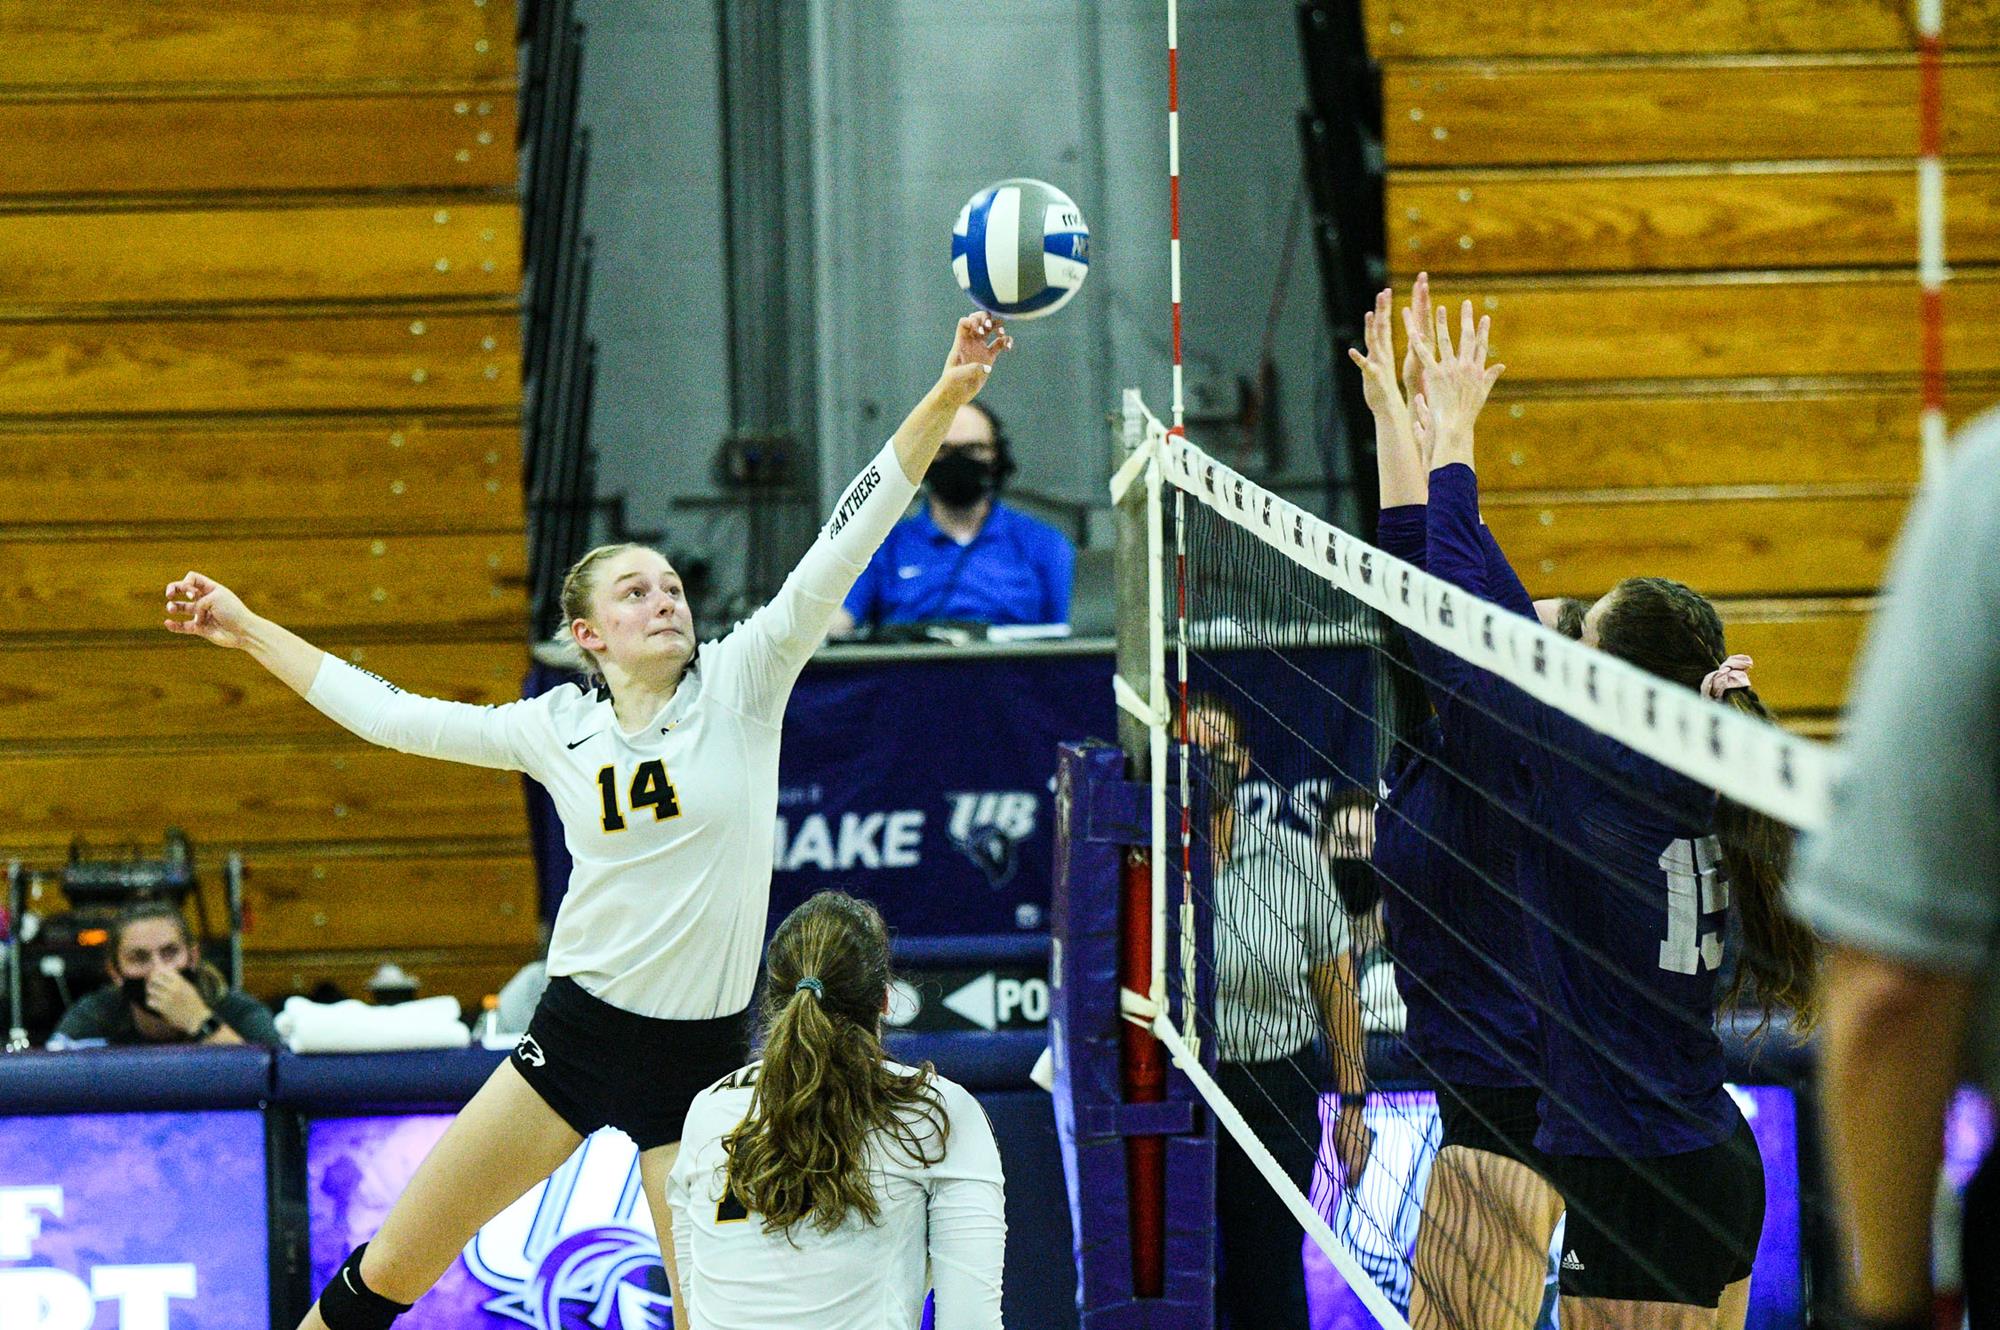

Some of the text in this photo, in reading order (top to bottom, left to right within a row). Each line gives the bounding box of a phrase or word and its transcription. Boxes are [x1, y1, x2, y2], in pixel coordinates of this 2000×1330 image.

[829, 465, 881, 540] PANTHERS
[598, 758, 682, 834] 14
[774, 810, 926, 871] AKE
